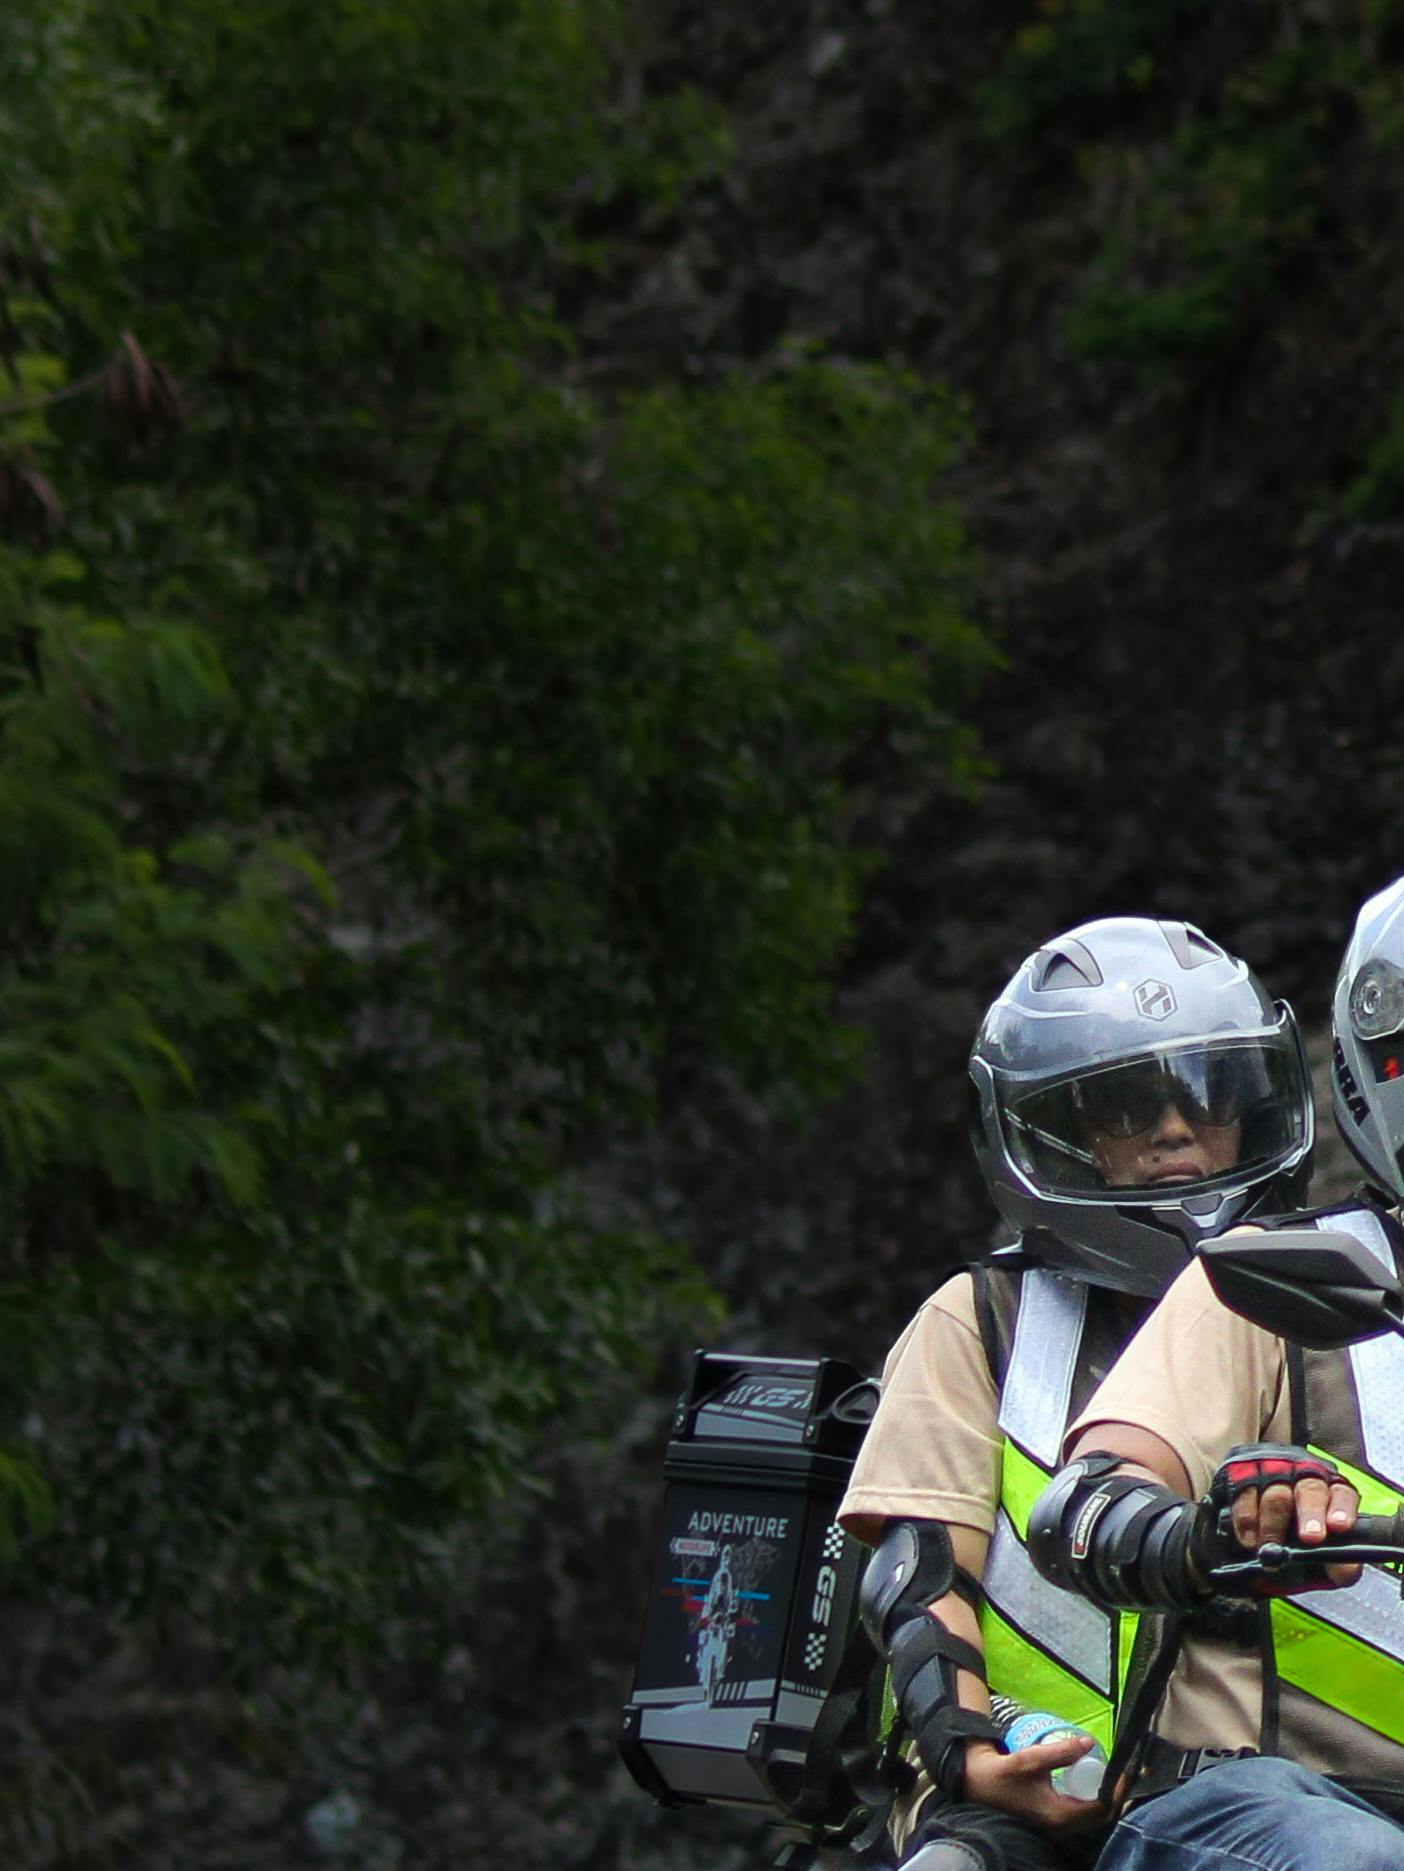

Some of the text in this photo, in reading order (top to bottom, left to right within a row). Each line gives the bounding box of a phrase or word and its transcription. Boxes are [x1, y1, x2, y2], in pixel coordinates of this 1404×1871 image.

[750, 1388, 808, 1407] GS
[687, 1511, 789, 1539] ADVENTURE
[812, 1565, 836, 1627] GS
